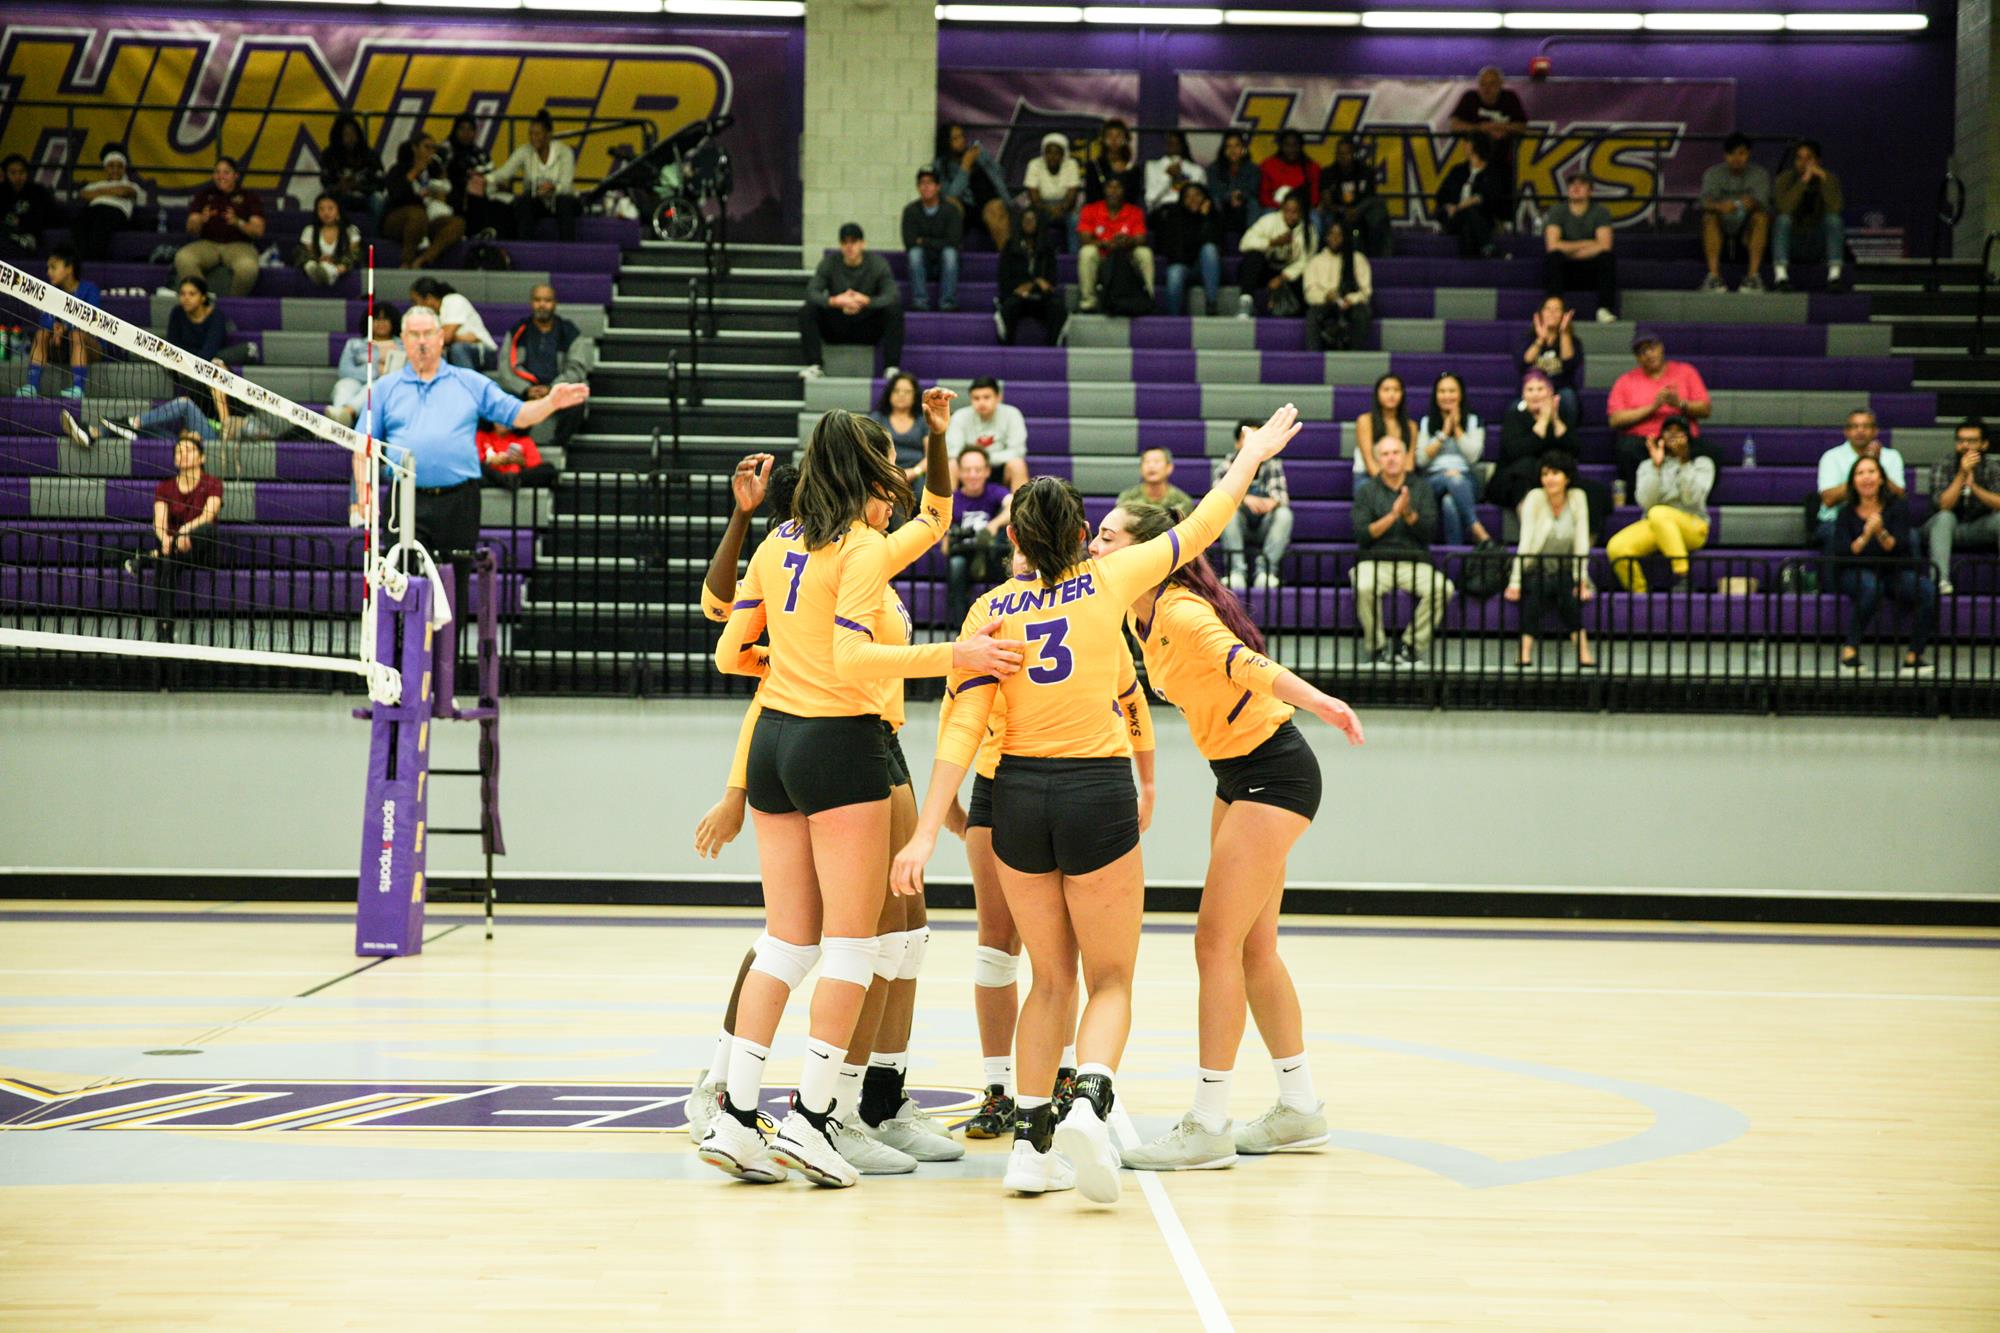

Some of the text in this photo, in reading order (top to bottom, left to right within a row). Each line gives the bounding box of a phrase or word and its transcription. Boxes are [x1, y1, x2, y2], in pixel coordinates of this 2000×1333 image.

[0, 26, 733, 206] HUNTER
[20, 275, 46, 302] HAWKS
[63, 296, 120, 336] HUNTER HAWKS
[783, 550, 809, 613] 7
[988, 573, 1096, 616] HUNTER
[1025, 616, 1073, 685] 3
